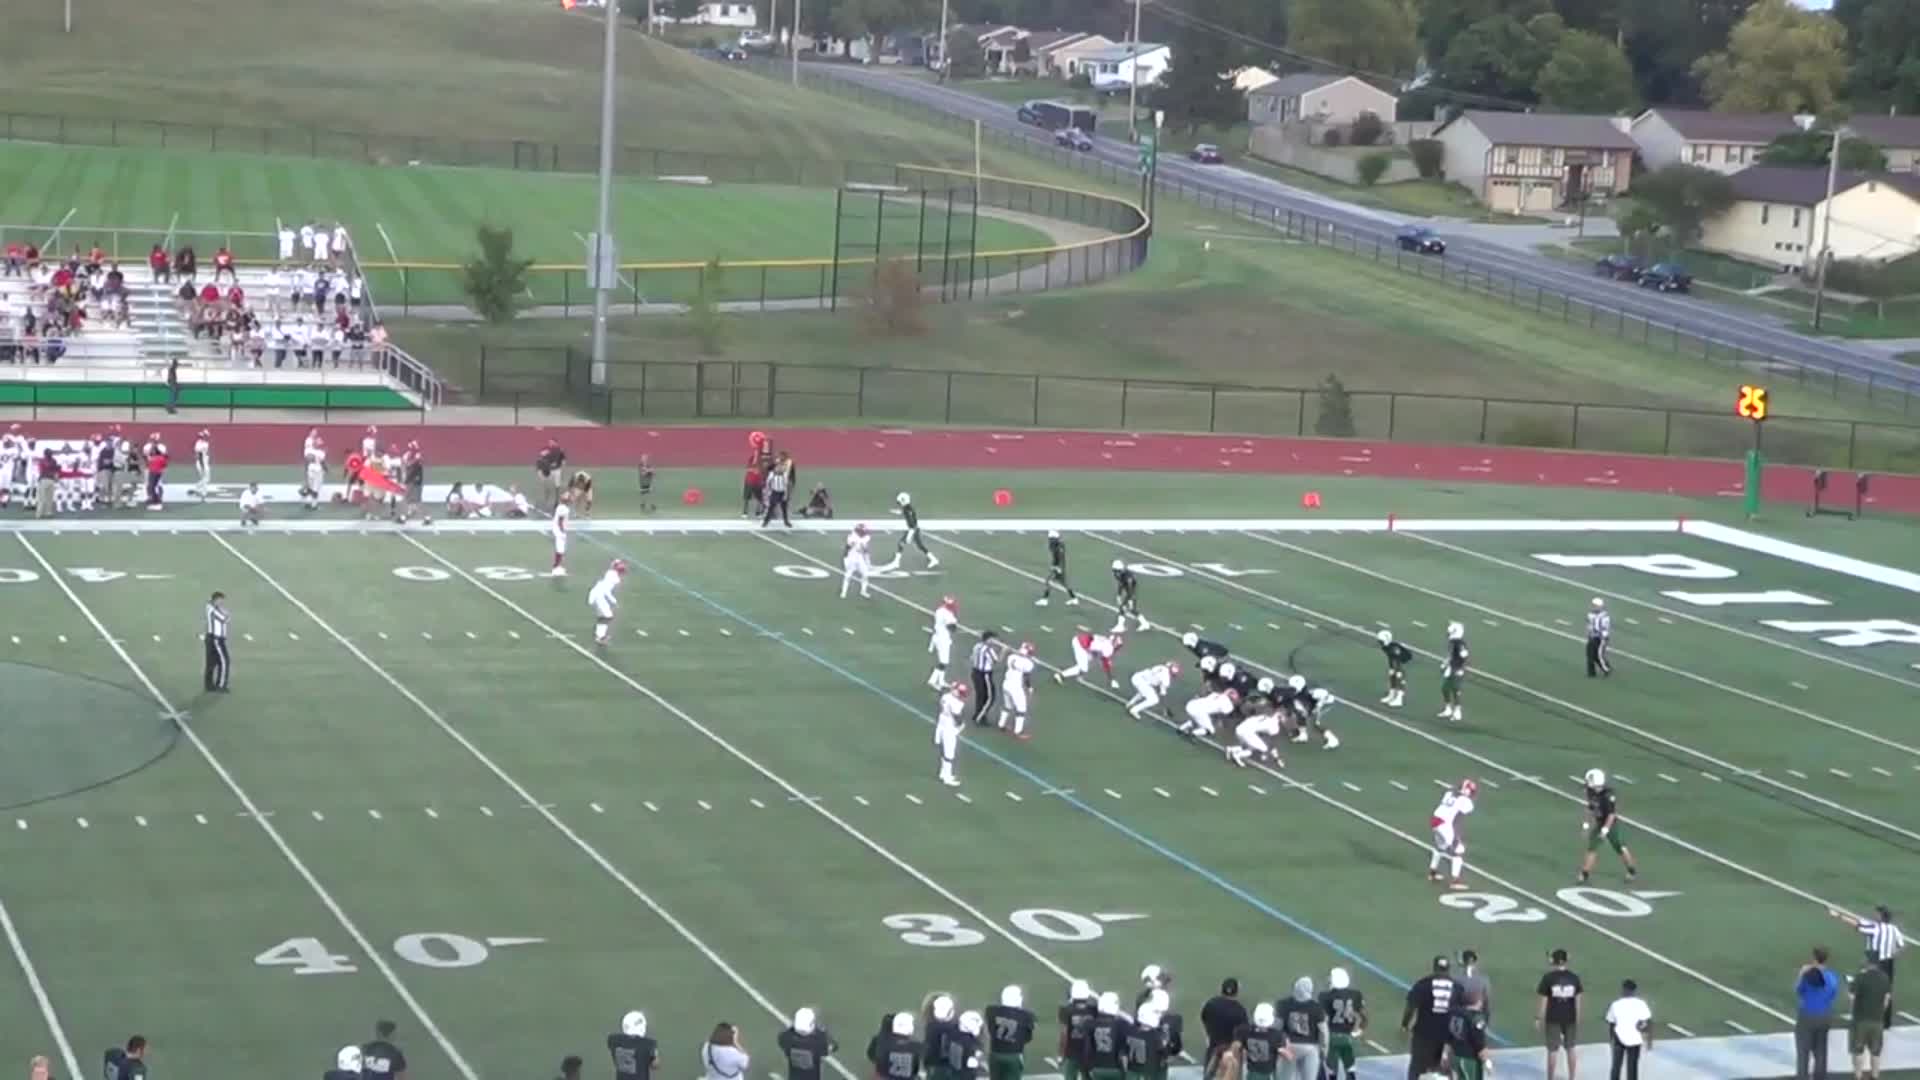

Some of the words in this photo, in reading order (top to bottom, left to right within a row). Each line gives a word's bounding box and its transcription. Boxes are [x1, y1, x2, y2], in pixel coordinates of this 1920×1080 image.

[1739, 386, 1765, 418] 25
[1439, 887, 1653, 922] 20
[882, 908, 1104, 947] 30
[255, 932, 489, 974] 40
